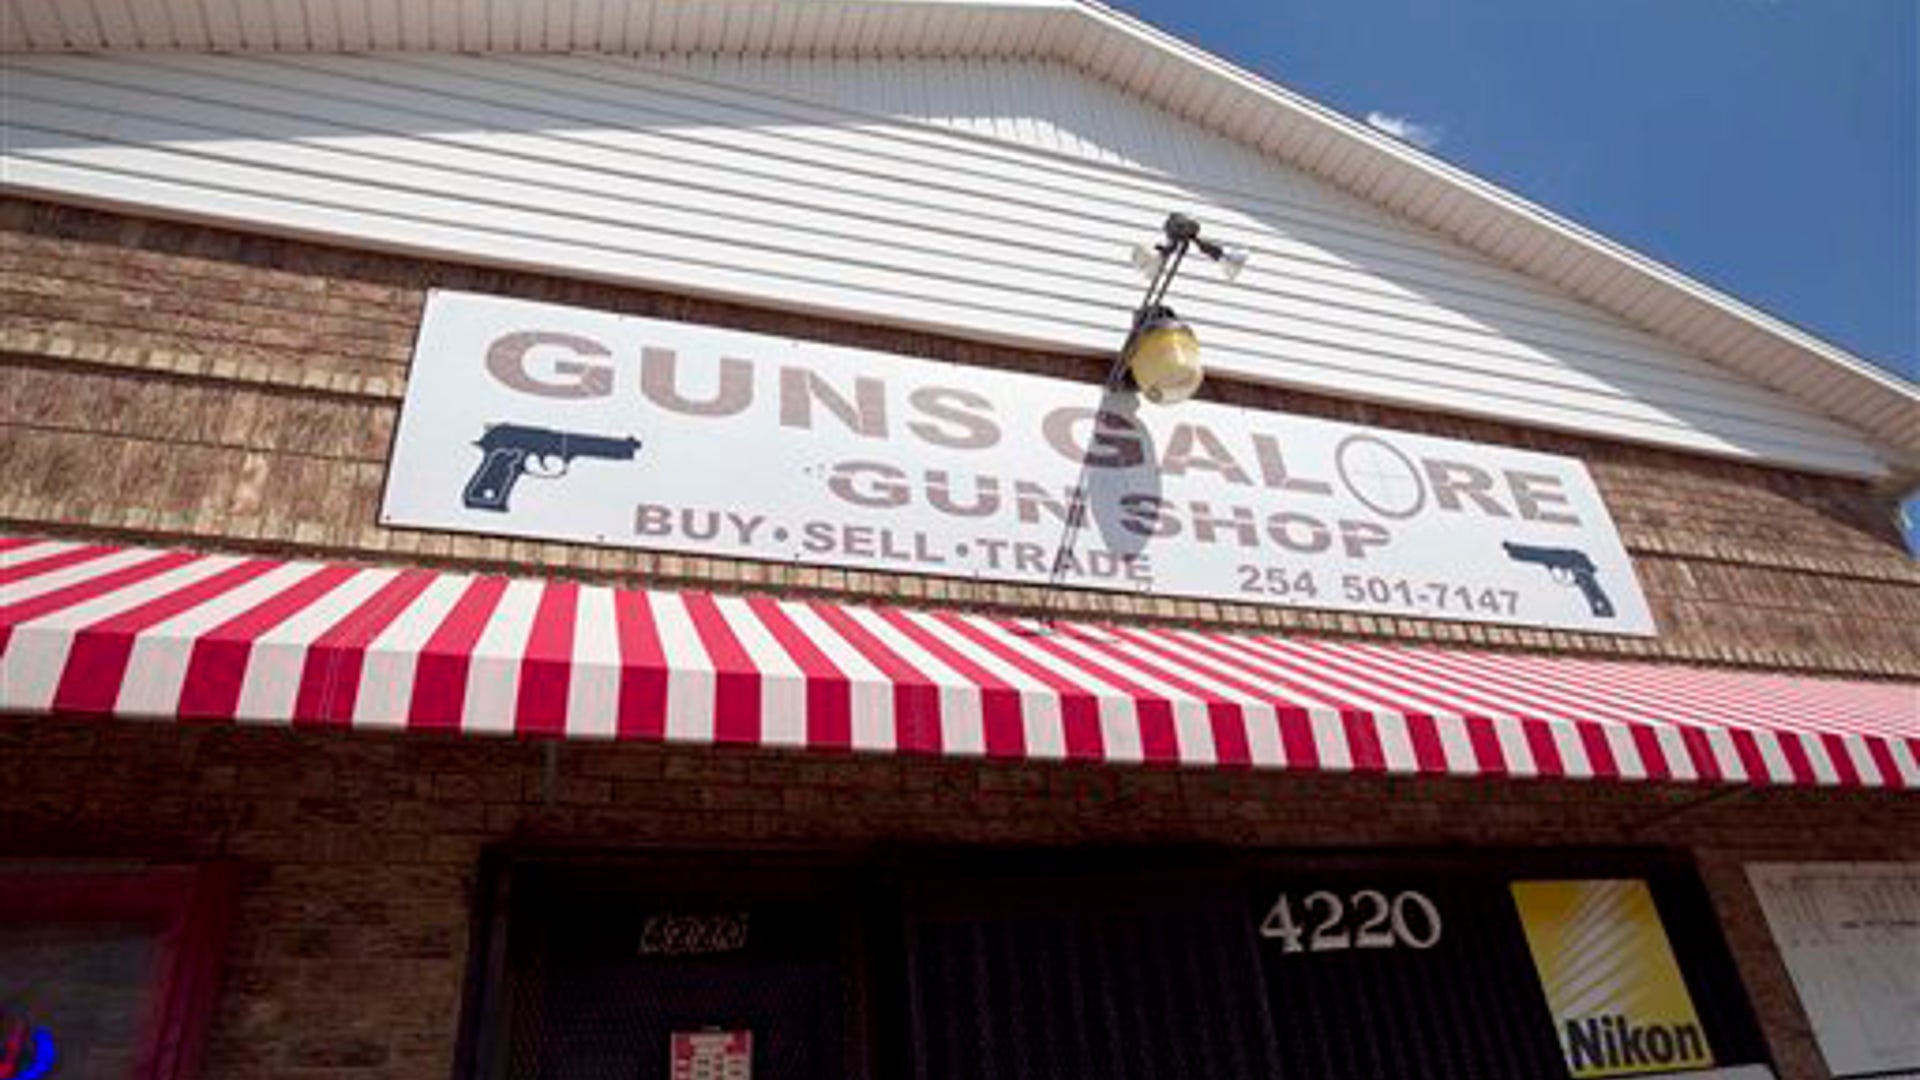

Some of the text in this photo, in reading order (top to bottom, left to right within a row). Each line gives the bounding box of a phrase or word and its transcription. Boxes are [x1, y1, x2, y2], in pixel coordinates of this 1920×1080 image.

[485, 331, 1581, 528] GUNS GALORE
[634, 504, 1153, 583] BUY SELL TRADE
[827, 461, 1392, 558] GUN SHOP
[1239, 565, 1520, 616] 254 501-7147
[1260, 890, 1442, 953] 4220
[1565, 1015, 1706, 1071] Nikon
